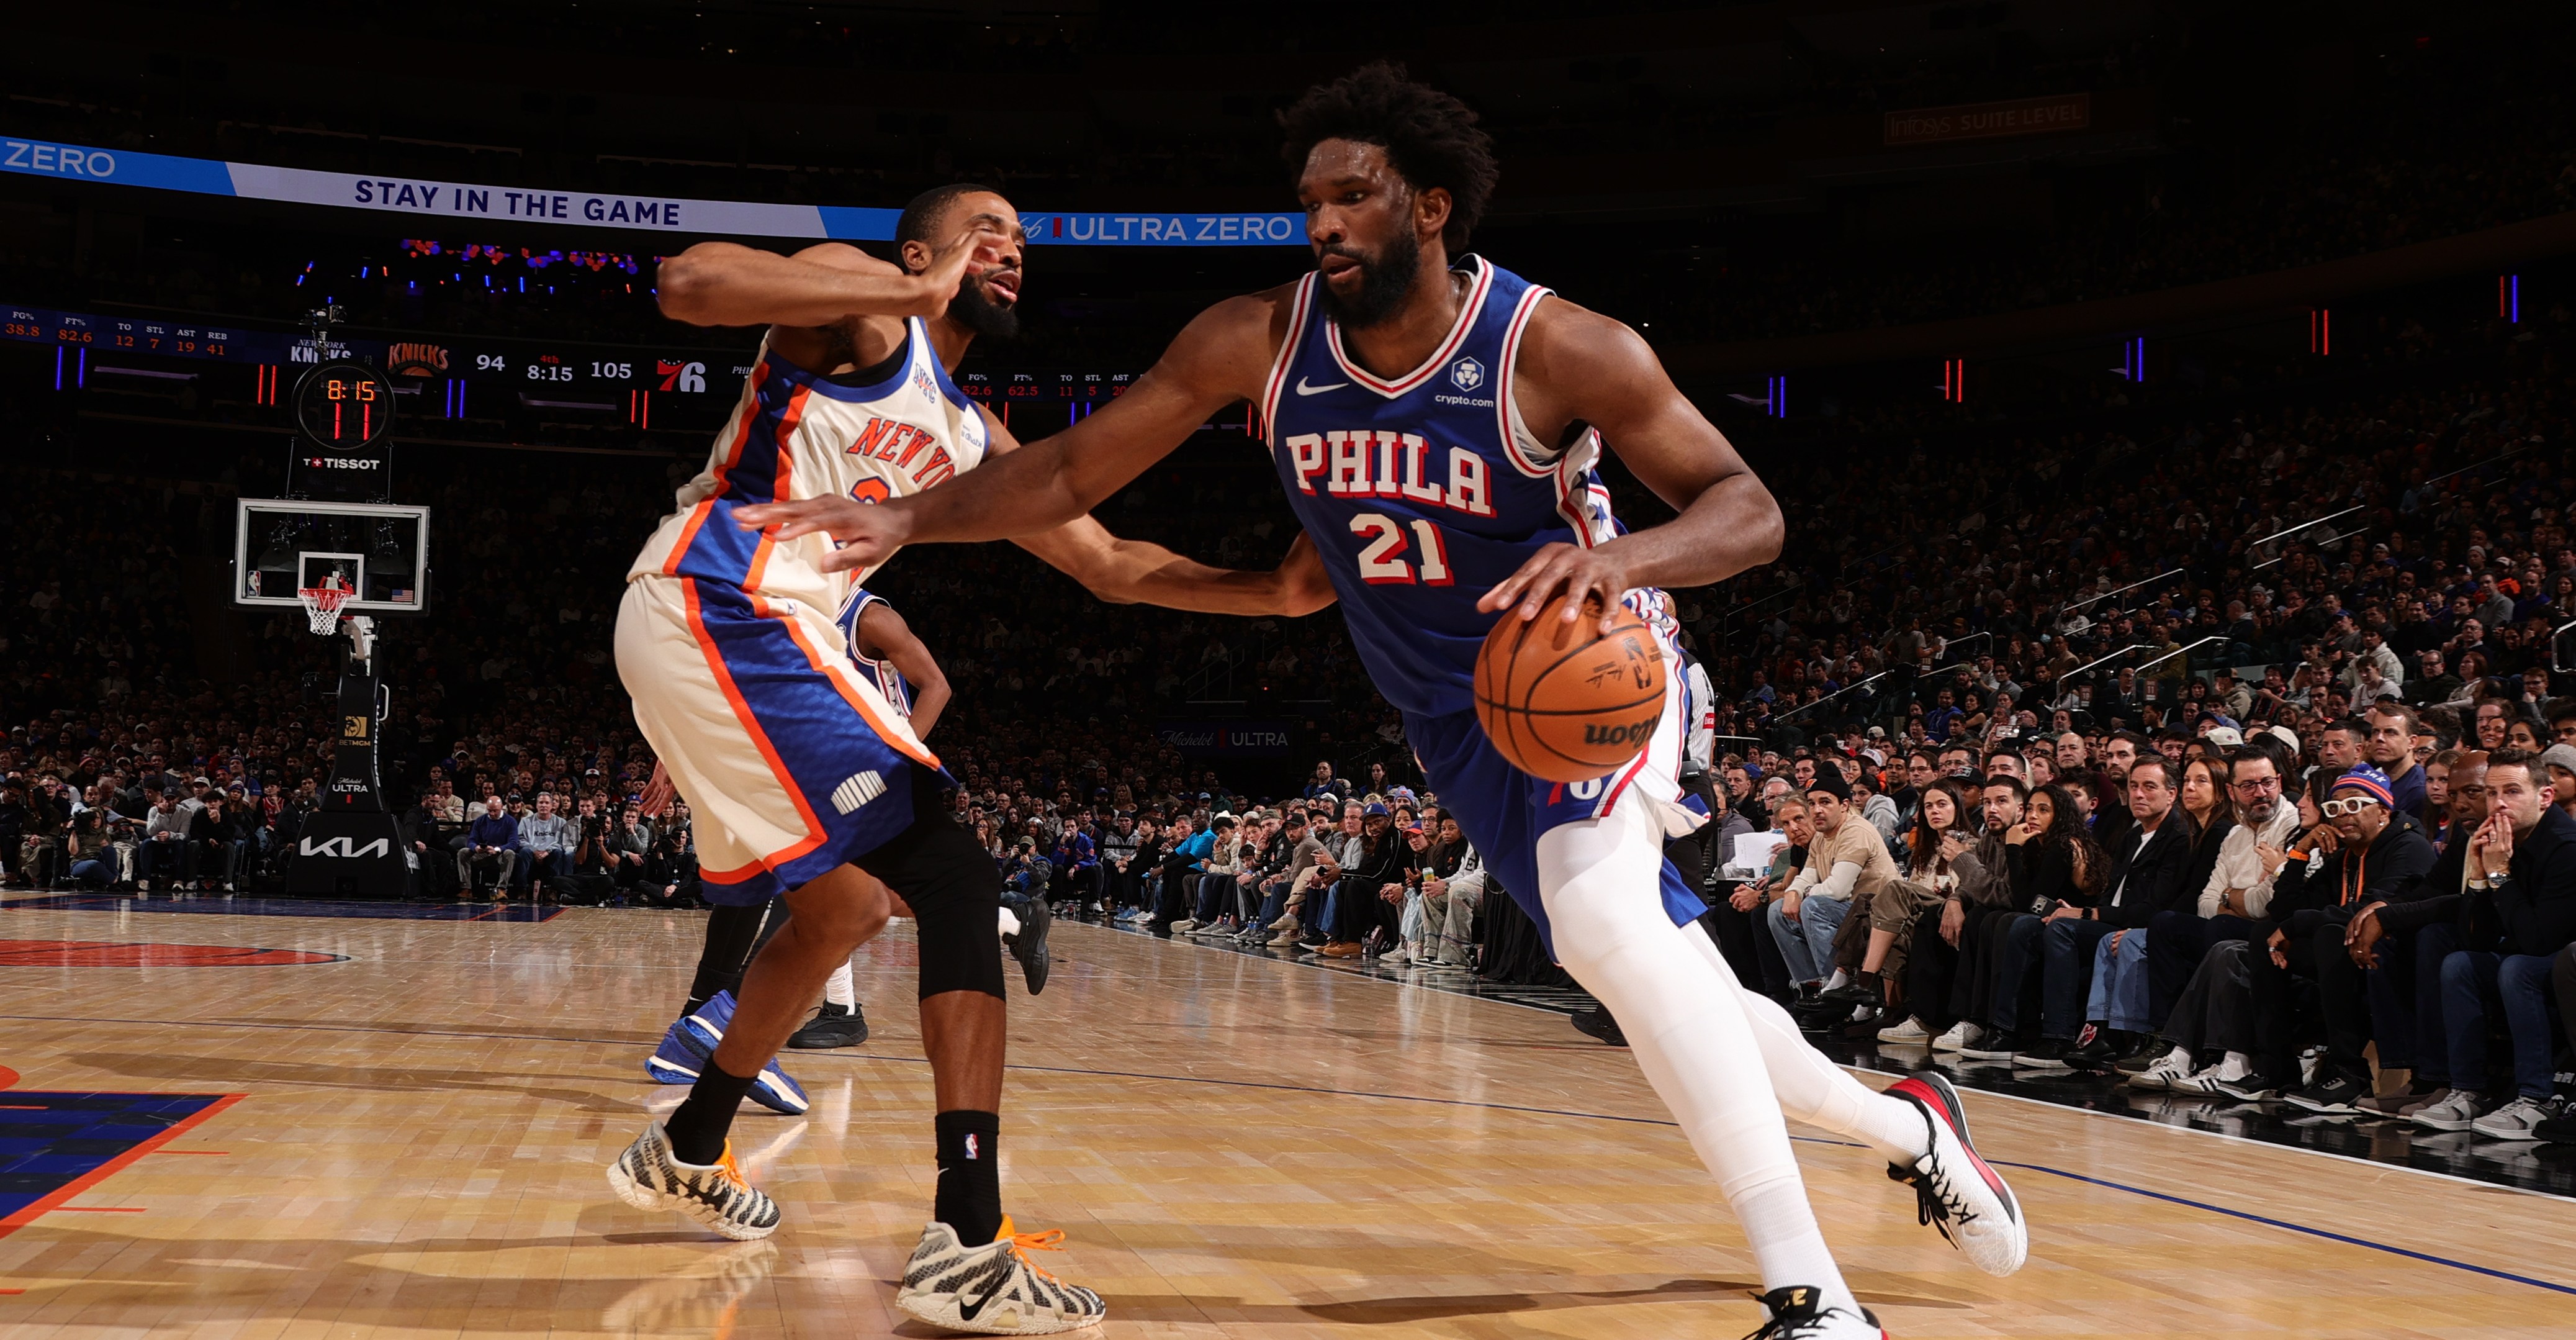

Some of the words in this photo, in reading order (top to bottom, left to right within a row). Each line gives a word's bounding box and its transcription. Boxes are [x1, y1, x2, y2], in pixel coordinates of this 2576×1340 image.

[1891, 115, 1952, 137] Infosys
[1960, 110, 2016, 131] SUITE
[2022, 104, 2081, 125] LEVEL
[4, 141, 115, 177] ZERO
[355, 180, 439, 209] STAY
[454, 188, 489, 213] IN
[505, 192, 568, 219] THE
[583, 198, 680, 225] GAME
[1070, 217, 1186, 241] ULTRA
[1195, 217, 1292, 241] ZERO
[12, 311, 34, 320] FG%
[65, 317, 86, 327] FT%
[118, 323, 132, 331] TO
[146, 325, 164, 335] STL
[177, 328, 196, 338] AST
[207, 332, 227, 340] REB
[5, 323, 40, 337] 38.8
[58, 330, 93, 343] 82.6
[115, 335, 134, 347] 12
[150, 338, 160, 349] 7
[177, 342, 196, 353] 19
[207, 344, 225, 356] 41
[290, 346, 352, 363] KNIKS
[388, 343, 449, 371] KNICKS
[476, 355, 505, 371] 94
[539, 355, 559, 364] 4th
[527, 365, 573, 382] 8:15
[592, 362, 632, 379] 105
[657, 359, 706, 393] 76
[328, 380, 375, 401] 8:15
[962, 386, 992, 396] 52.6
[1008, 386, 1038, 396] 62.5
[1060, 387, 1073, 396] 11
[1089, 386, 1097, 396] 5
[1434, 394, 1494, 408] crypto.com
[335, 402, 370, 440] 11
[324, 458, 380, 470] TISSOT
[845, 417, 935, 469] NEW
[912, 445, 955, 491] YO
[1286, 430, 1497, 518] PHILA
[1349, 513, 1454, 586] 21
[339, 739, 371, 747] BETMGM
[1159, 730, 1214, 746] Michelob
[1231, 732, 1289, 746] ULTRA
[1585, 715, 1658, 749] ilson
[332, 784, 369, 792] ULTRA
[300, 836, 389, 859] KIA
[644, 1136, 655, 1167] TWELVE
